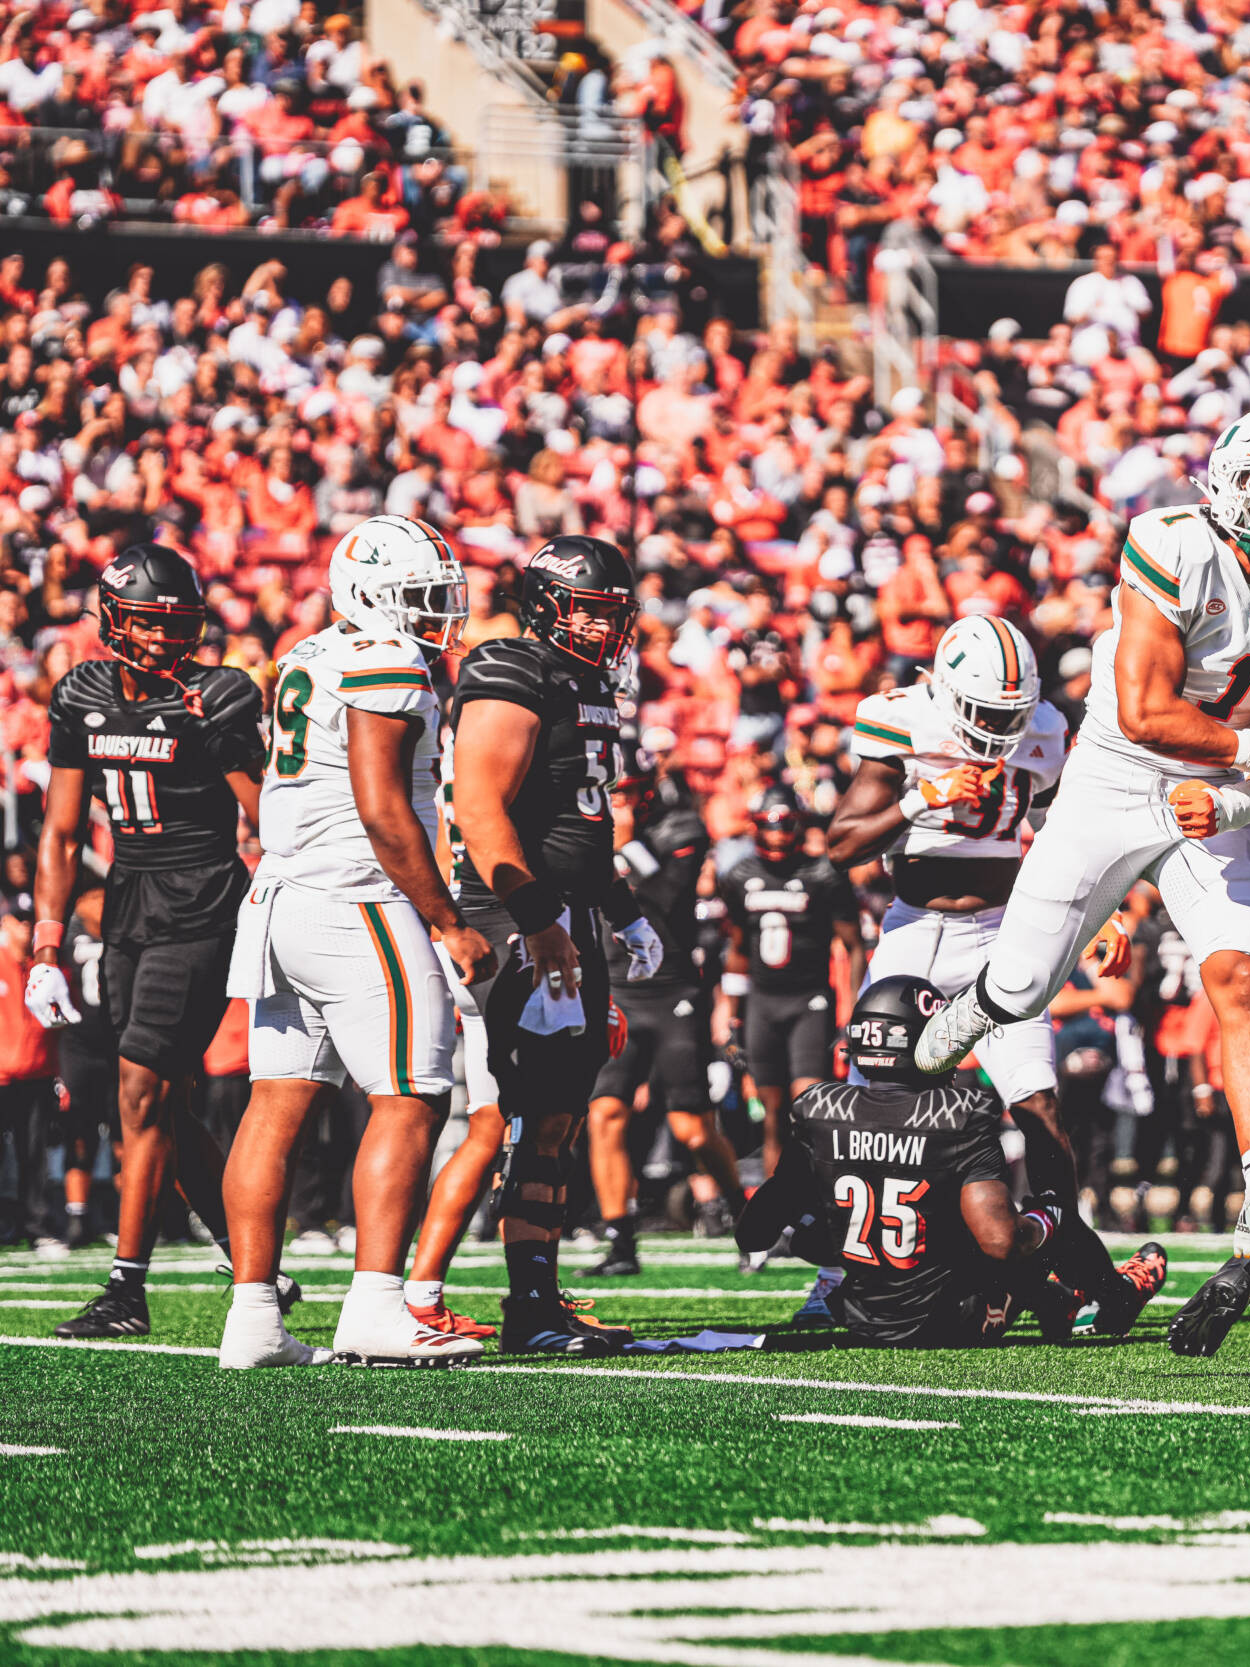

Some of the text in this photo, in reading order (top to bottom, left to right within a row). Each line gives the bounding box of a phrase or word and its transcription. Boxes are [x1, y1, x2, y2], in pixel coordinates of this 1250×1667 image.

[88, 734, 178, 763] LOUISVILLE
[102, 768, 163, 834] 11
[861, 1020, 884, 1047] 25
[849, 1130, 927, 1166] BROWN
[834, 1174, 931, 1270] 25
